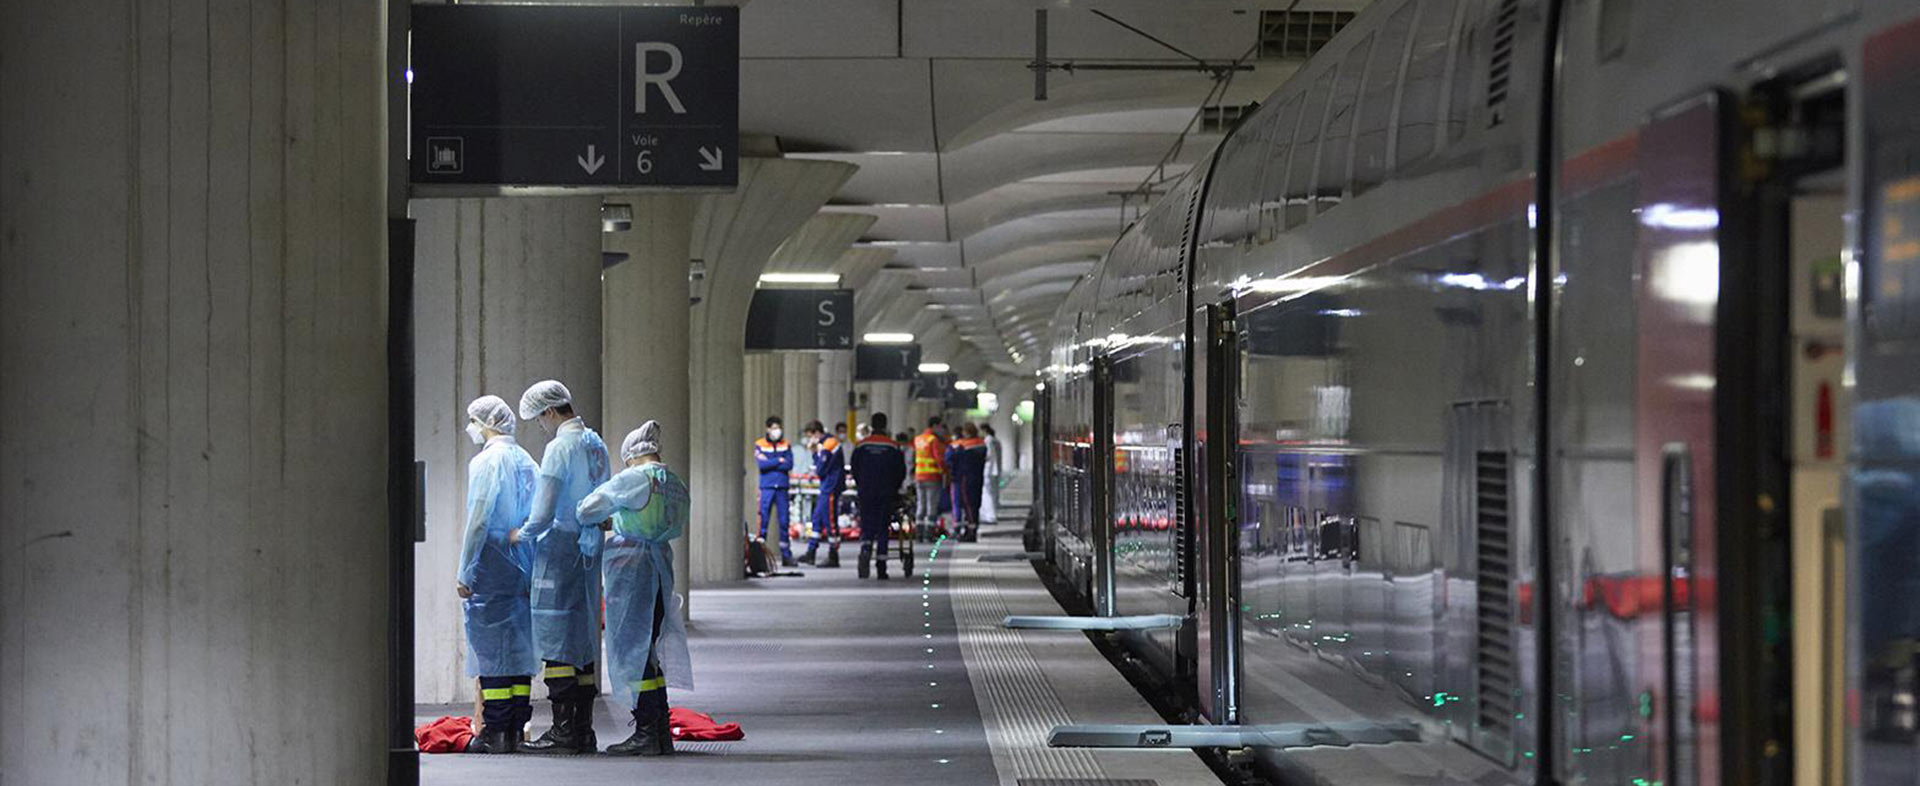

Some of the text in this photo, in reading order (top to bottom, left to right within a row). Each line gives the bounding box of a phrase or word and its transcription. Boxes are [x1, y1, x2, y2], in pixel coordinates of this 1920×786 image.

[680, 13, 722, 28] Repère
[635, 42, 687, 114] R
[632, 134, 659, 146] Voie
[637, 150, 652, 174] 6
[818, 300, 835, 326] S
[900, 350, 911, 366] T
